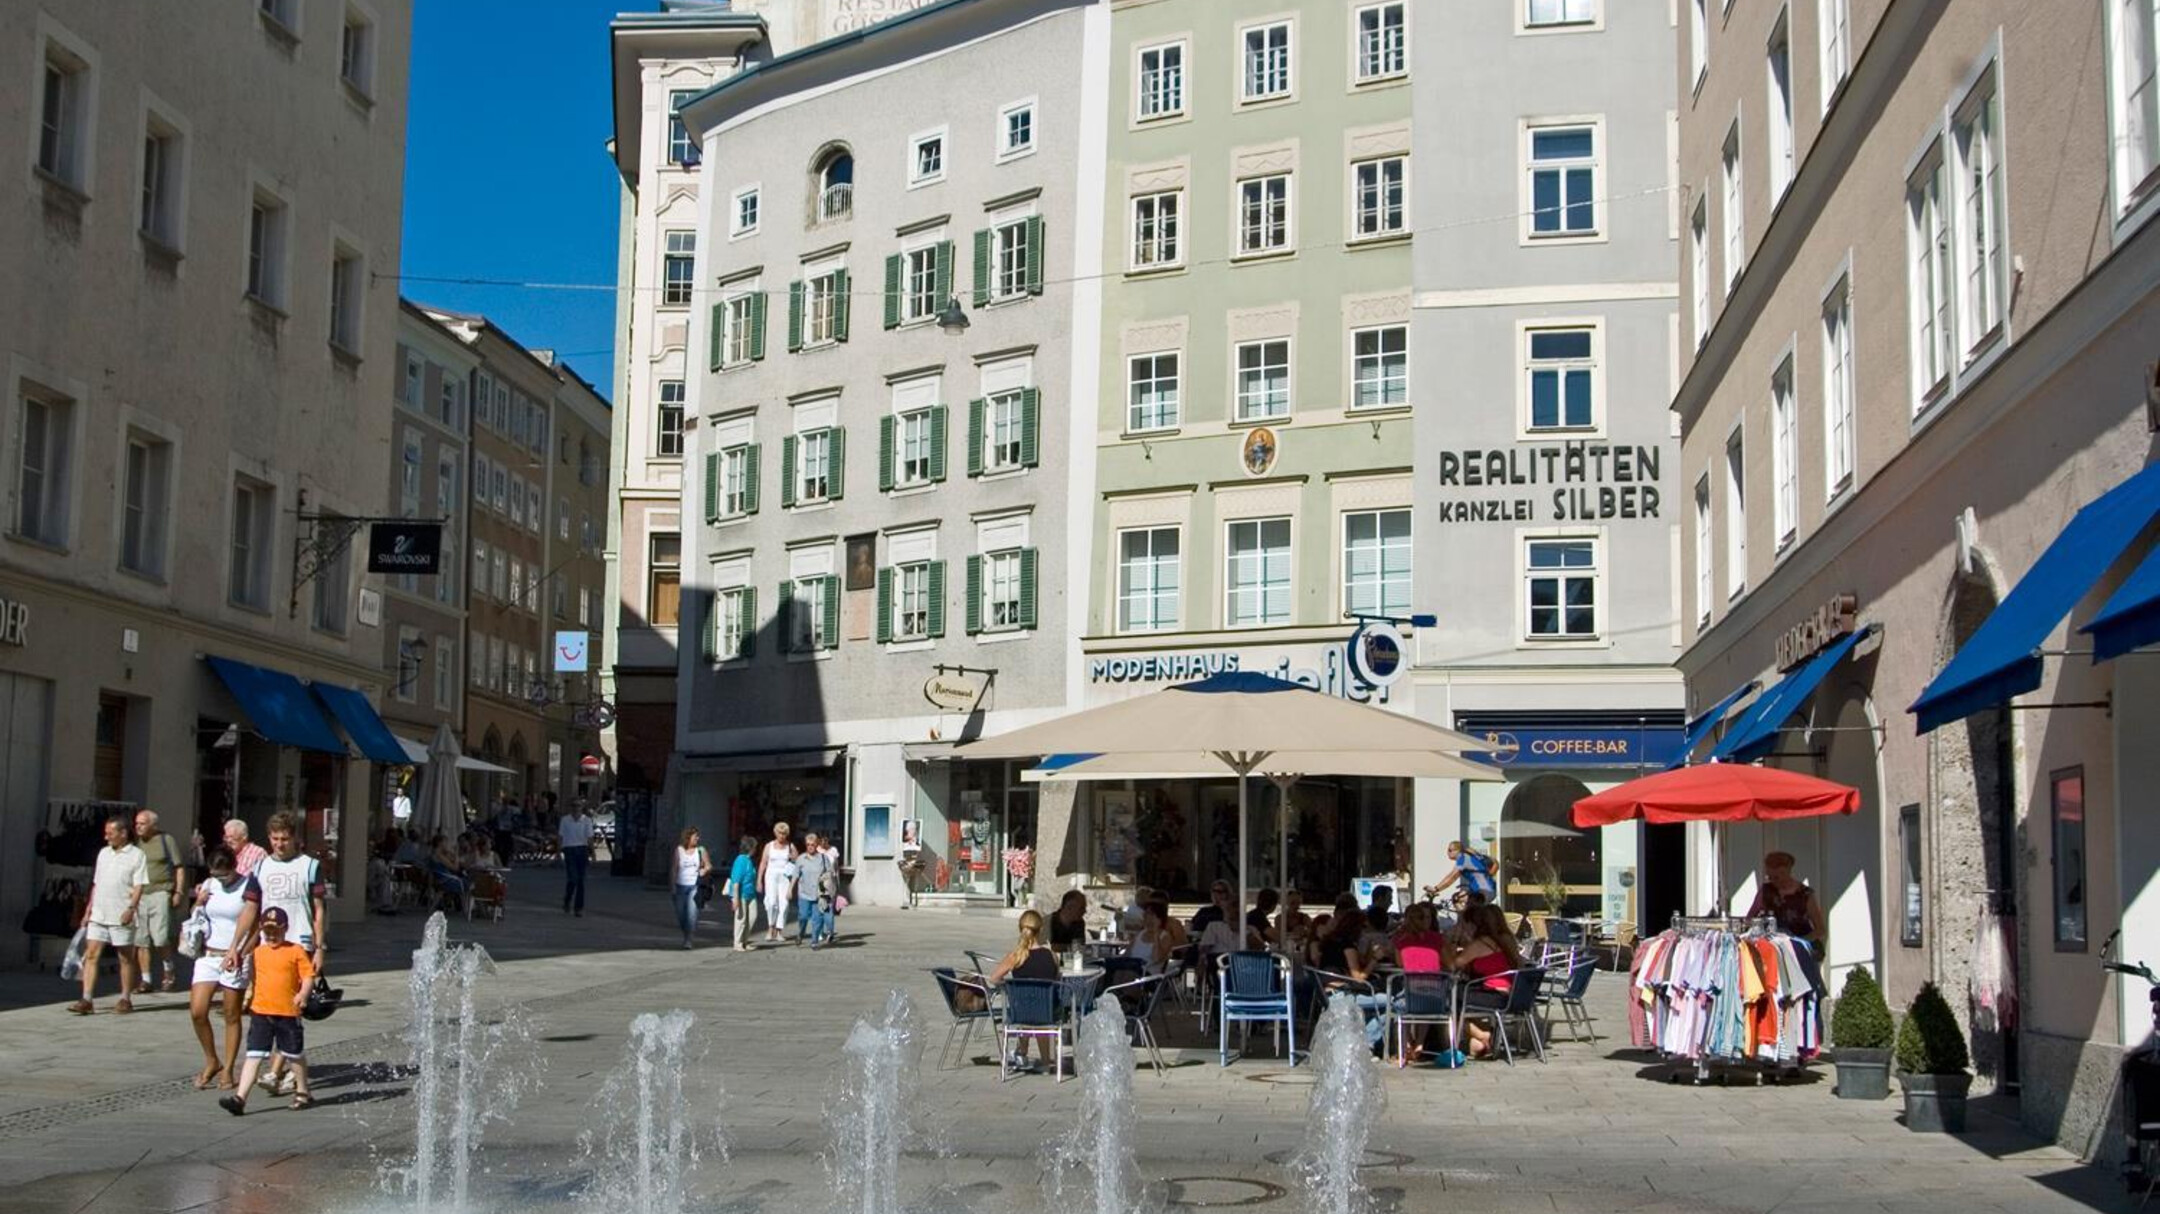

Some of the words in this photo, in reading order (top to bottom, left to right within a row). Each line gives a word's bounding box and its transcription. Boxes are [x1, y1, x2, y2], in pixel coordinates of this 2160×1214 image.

[1440, 440, 1660, 486] REALITÄTEN
[1440, 499, 1533, 523] KANZLEI
[1553, 485, 1660, 520] SILBER
[1092, 653, 1240, 682] MODENHAUS
[1531, 739, 1628, 754] COFFEE-BAR
[266, 871, 300, 900] 21
